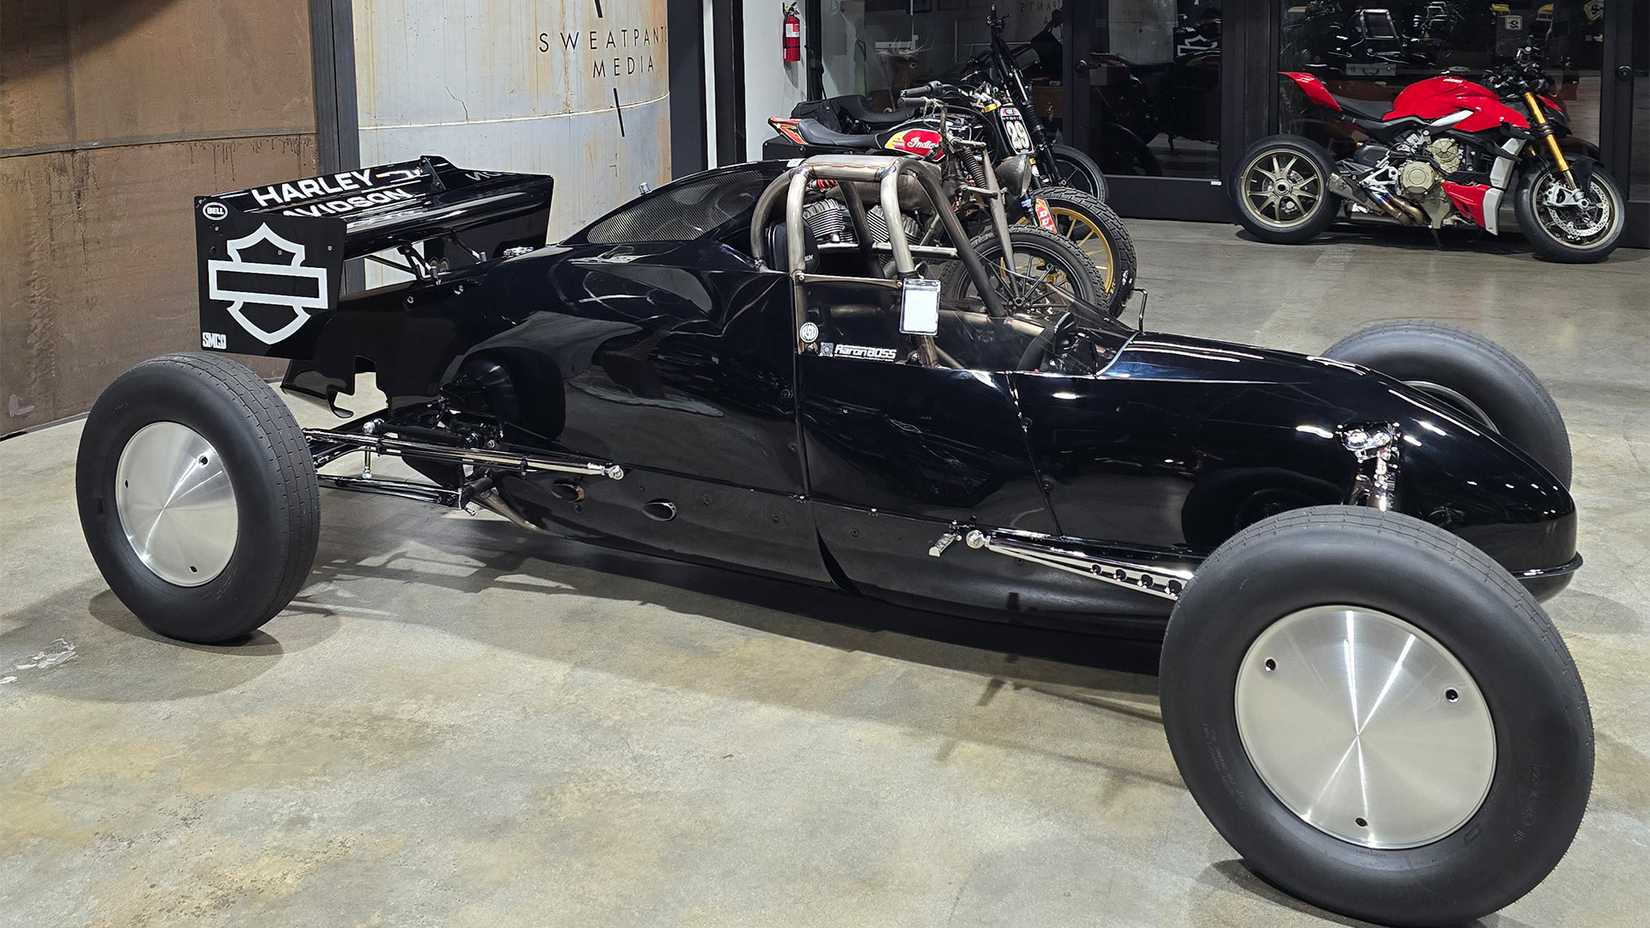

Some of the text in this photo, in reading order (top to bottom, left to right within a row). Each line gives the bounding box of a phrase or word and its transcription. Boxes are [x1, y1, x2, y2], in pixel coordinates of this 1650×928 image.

[539, 28, 667, 53] SWEATPANT
[592, 56, 654, 78] MEDIA
[206, 206, 225, 215] BELL
[283, 189, 414, 217] VIDSON
